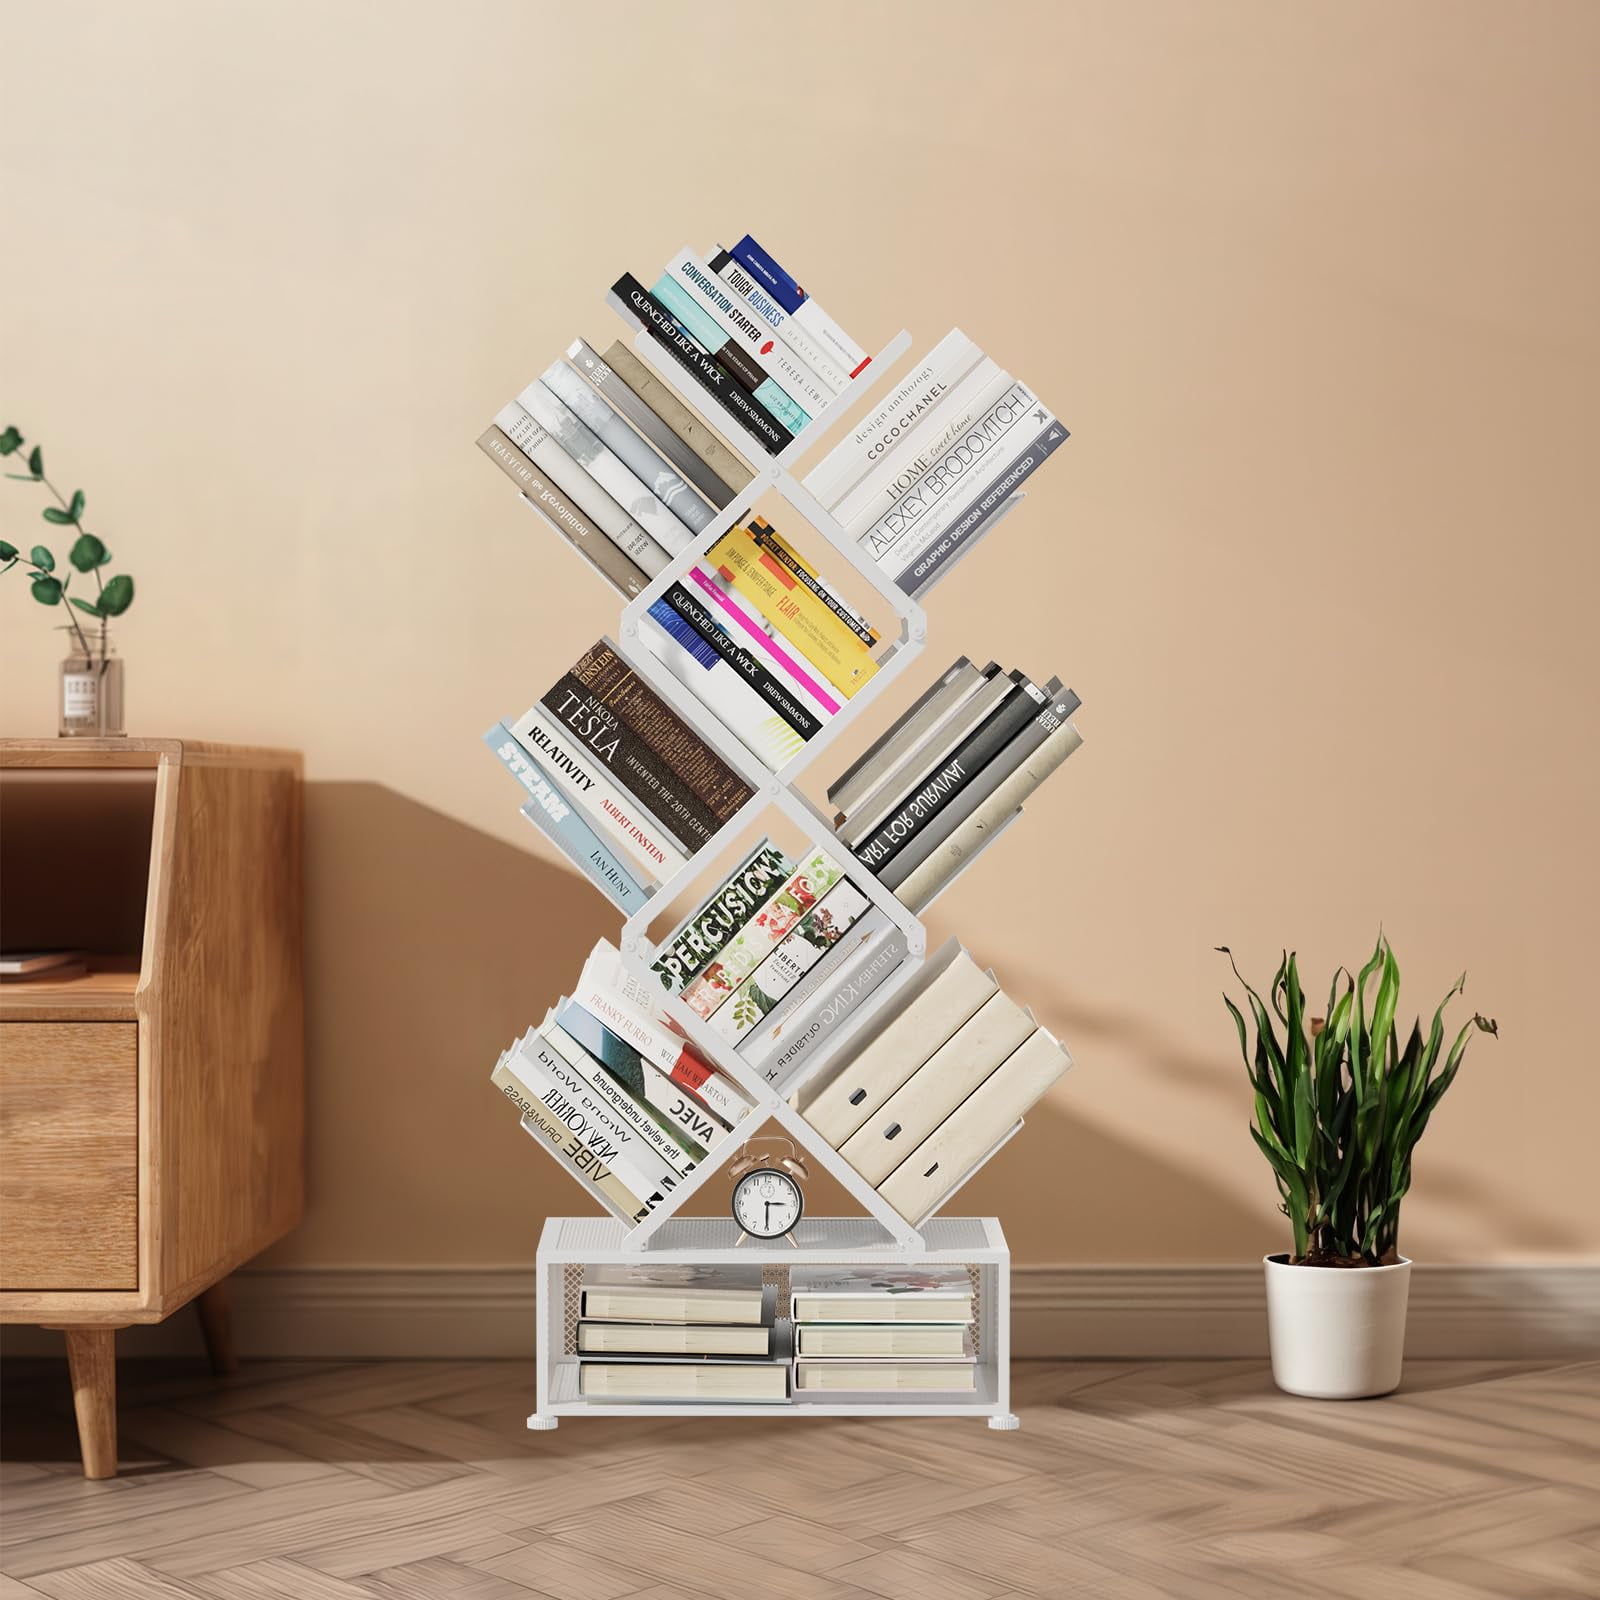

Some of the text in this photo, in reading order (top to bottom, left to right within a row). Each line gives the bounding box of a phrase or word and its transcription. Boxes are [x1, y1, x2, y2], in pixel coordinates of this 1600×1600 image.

[680, 260, 734, 313] CONVERSATION
[727, 307, 763, 342] STARTER
[725, 268, 754, 297] TOUGH
[746, 289, 785, 327] BUSINESS
[628, 289, 677, 337] QUENCHED
[673, 333, 694, 354] LIKE
[689, 350, 701, 361] A
[697, 358, 725, 385] WICK
[786, 329, 819, 362] DENISE
[776, 357, 828, 408] TERESA LEWIS
[852, 363, 935, 447] design anthology
[727, 390, 781, 442] DREW SIMMONS
[865, 391, 1025, 554] ALEXEY BRODOVITCH
[885, 409, 973, 500] HOME sweet home
[912, 454, 1035, 578] GRAPHIC DESIGN REFERENCED
[775, 594, 801, 620] FLAIR
[794, 568, 820, 593] FOCUSING
[816, 588, 828, 600] ON
[823, 596, 839, 611] YOUR
[834, 606, 862, 633] CUSTOMER
[670, 590, 760, 677] QUENCHED LIKE A WICK
[578, 648, 614, 685] EINSTEIN
[550, 688, 628, 762] TESLA
[583, 695, 621, 731] NIKOLA
[762, 681, 811, 729] DREW SIMMONS
[496, 740, 571, 823] STEAM
[527, 725, 595, 793] RELATIVITY
[624, 754, 661, 789] INVENTED
[655, 785, 674, 803] THE
[669, 799, 691, 820] 20TH
[599, 797, 666, 864] ALBERT EINSTEIN
[589, 849, 632, 898] IAN HUNT
[589, 993, 653, 1046] FRANKY FURBO
[659, 1048, 730, 1107] WILLIAM WHARTON
